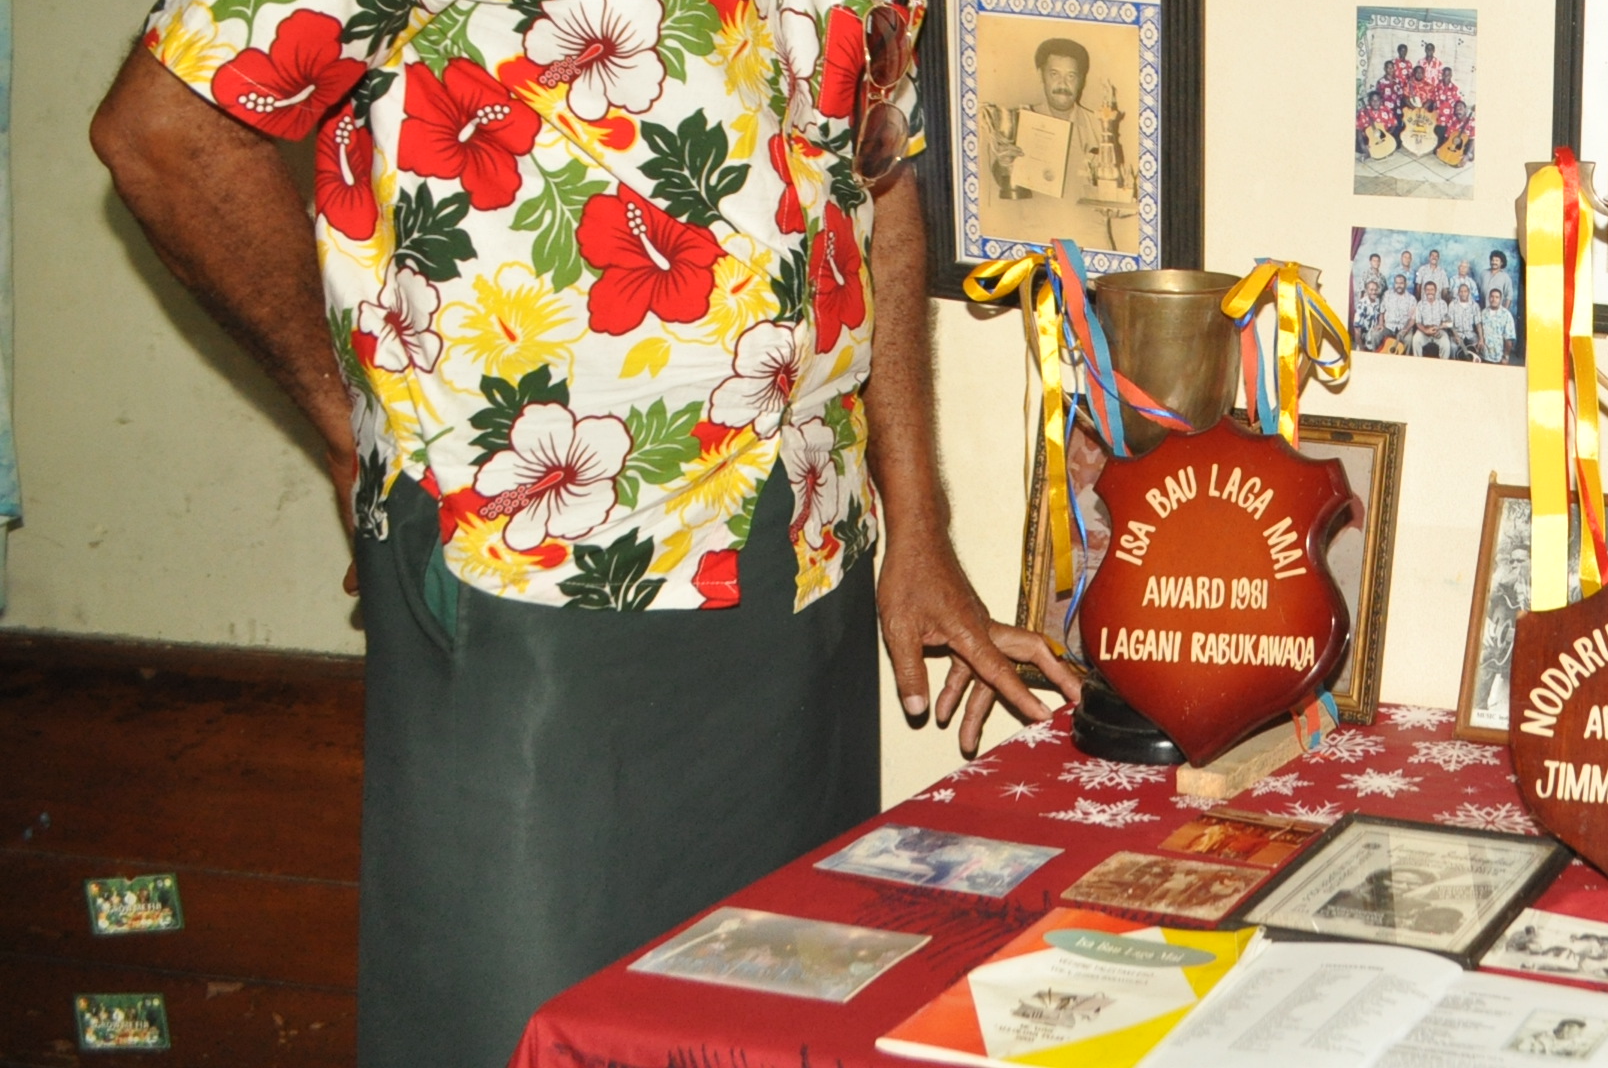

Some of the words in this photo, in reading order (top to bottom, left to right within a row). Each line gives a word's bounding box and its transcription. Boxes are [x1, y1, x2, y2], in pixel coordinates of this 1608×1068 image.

[1114, 519, 1156, 566] ISA
[1145, 465, 1197, 519] BAU
[1208, 463, 1274, 520] LAGA
[1262, 516, 1307, 580] MAI
[1142, 575, 1225, 609] AWARD
[1230, 578, 1269, 611] 1981
[1100, 627, 1182, 663] LAGANI
[1190, 631, 1316, 671] RABUKAWAQA
